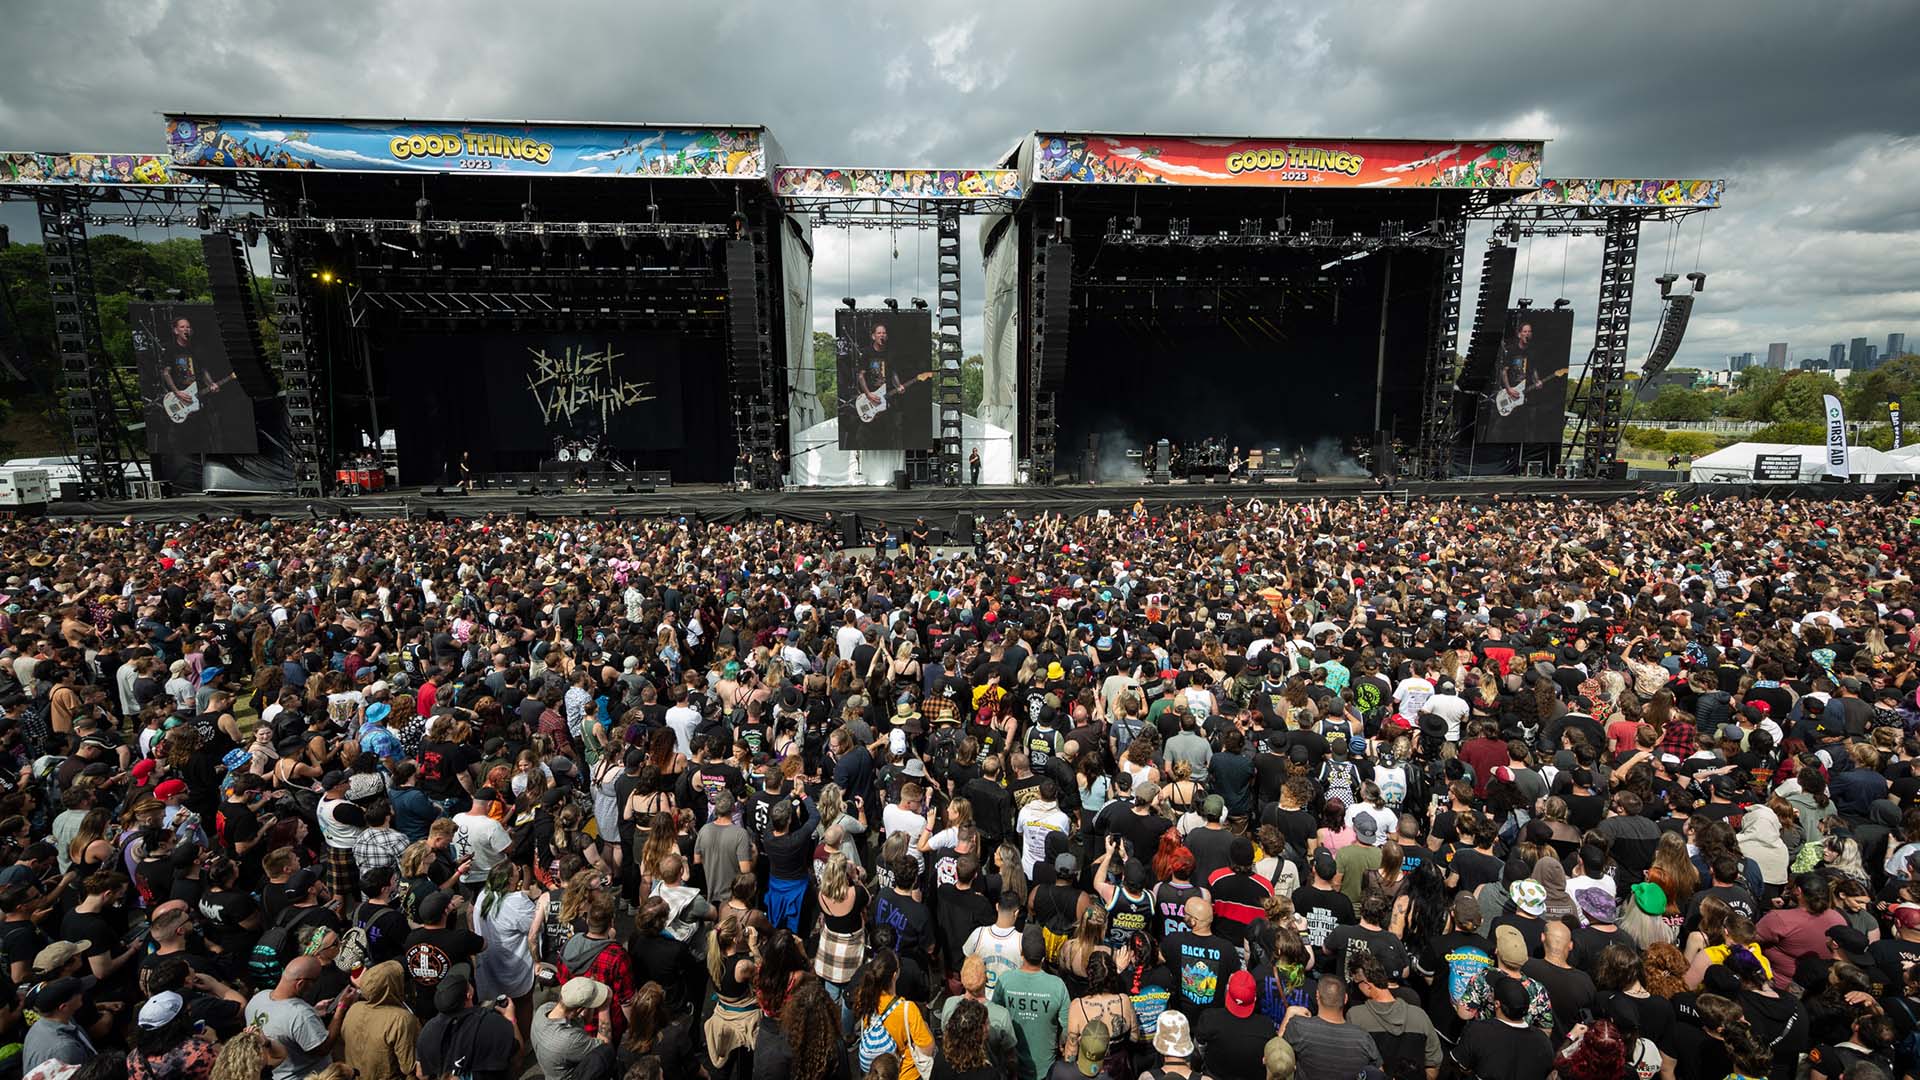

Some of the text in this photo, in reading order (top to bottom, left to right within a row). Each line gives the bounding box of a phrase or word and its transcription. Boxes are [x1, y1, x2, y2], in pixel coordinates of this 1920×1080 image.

[389, 133, 554, 165] GOOD THINGS
[459, 159, 492, 169] 2023
[1226, 147, 1364, 176] GOOD THINGS
[1281, 172, 1308, 181] 2023
[527, 342, 625, 386] BULLET
[527, 373, 656, 434] VALENTINE
[1831, 420, 1844, 466] FIRST AID
[1161, 902, 1185, 916] STA
[1113, 918, 1147, 930] THINGS
[1116, 912, 1145, 922] GOOD
[1181, 943, 1221, 960] BACK TO
[1444, 953, 1468, 961] GOOD
[1008, 996, 1050, 1013] KSCY
[1129, 994, 1148, 1002] GOOD
